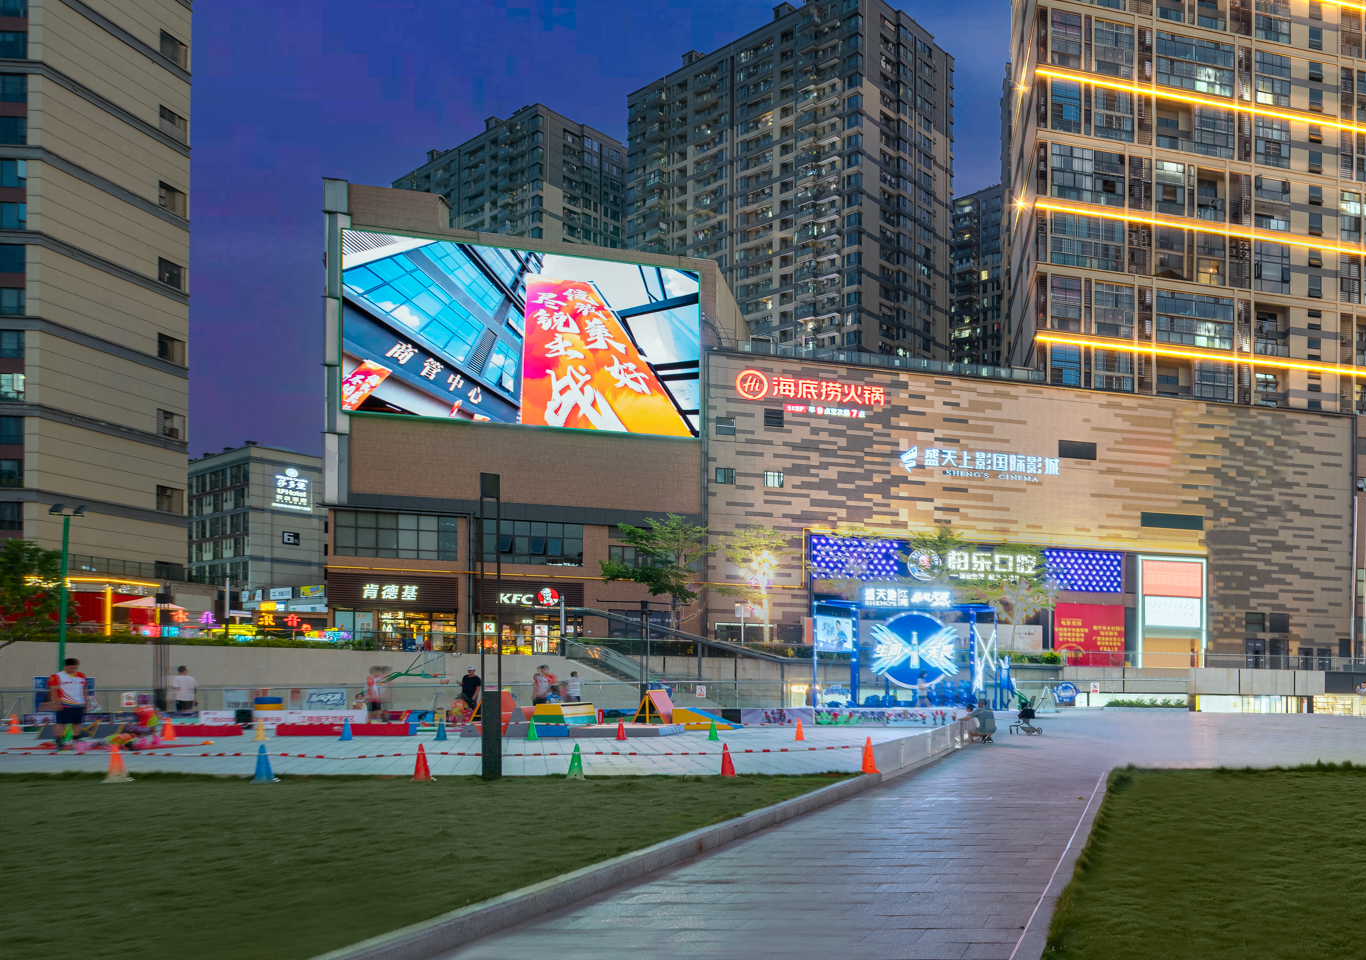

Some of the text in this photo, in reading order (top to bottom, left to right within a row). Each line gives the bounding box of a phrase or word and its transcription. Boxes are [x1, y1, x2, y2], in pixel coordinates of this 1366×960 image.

[385, 341, 483, 405] 商管中心
[771, 376, 886, 407] 海底捞火锅
[924, 447, 1061, 476] 盛天上影国际影城
[997, 473, 1039, 483] CINEMA
[362, 583, 419, 601] 肯德基
[499, 592, 534, 605] KFC
